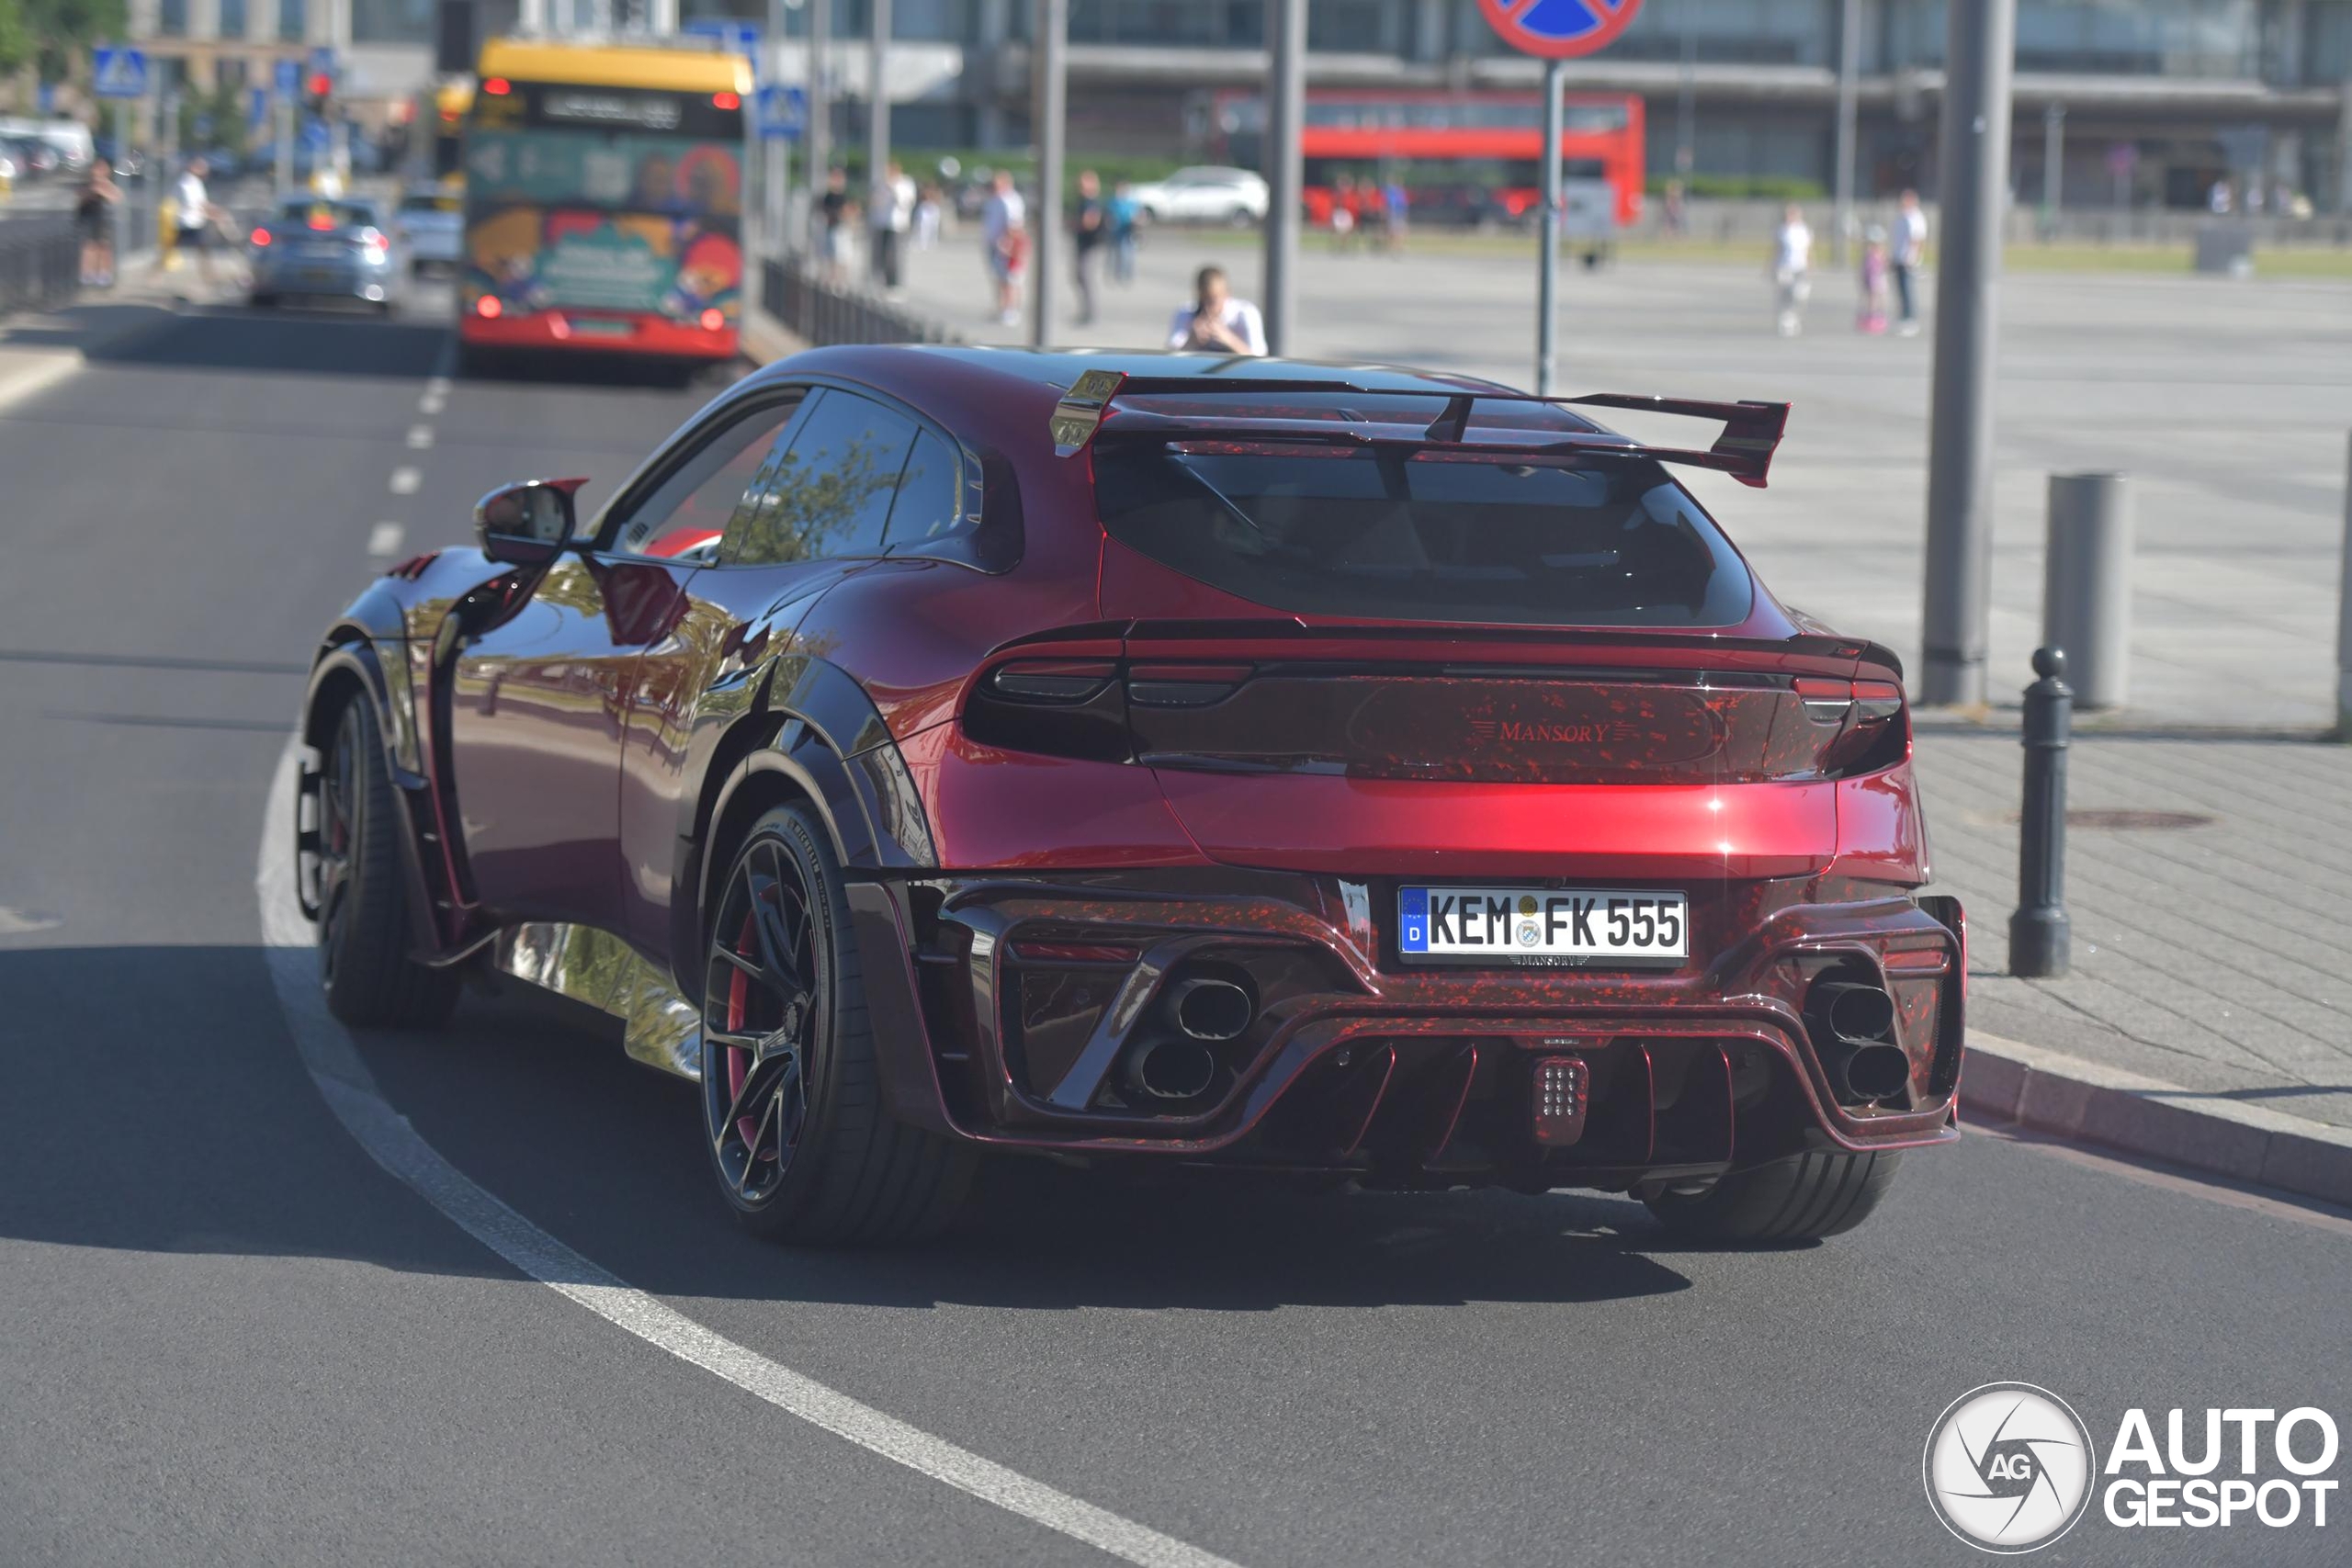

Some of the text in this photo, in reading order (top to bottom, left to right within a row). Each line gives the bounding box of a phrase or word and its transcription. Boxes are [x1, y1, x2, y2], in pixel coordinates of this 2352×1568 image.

[1500, 722, 1610, 742] MANSORY
[793, 825, 821, 873] MICHELIN
[1430, 896, 1510, 945] KEM
[1545, 897, 1597, 946] FK
[1608, 899, 1680, 947] 555
[1409, 928, 1420, 942] D
[1521, 955, 1576, 966] MANSORY
